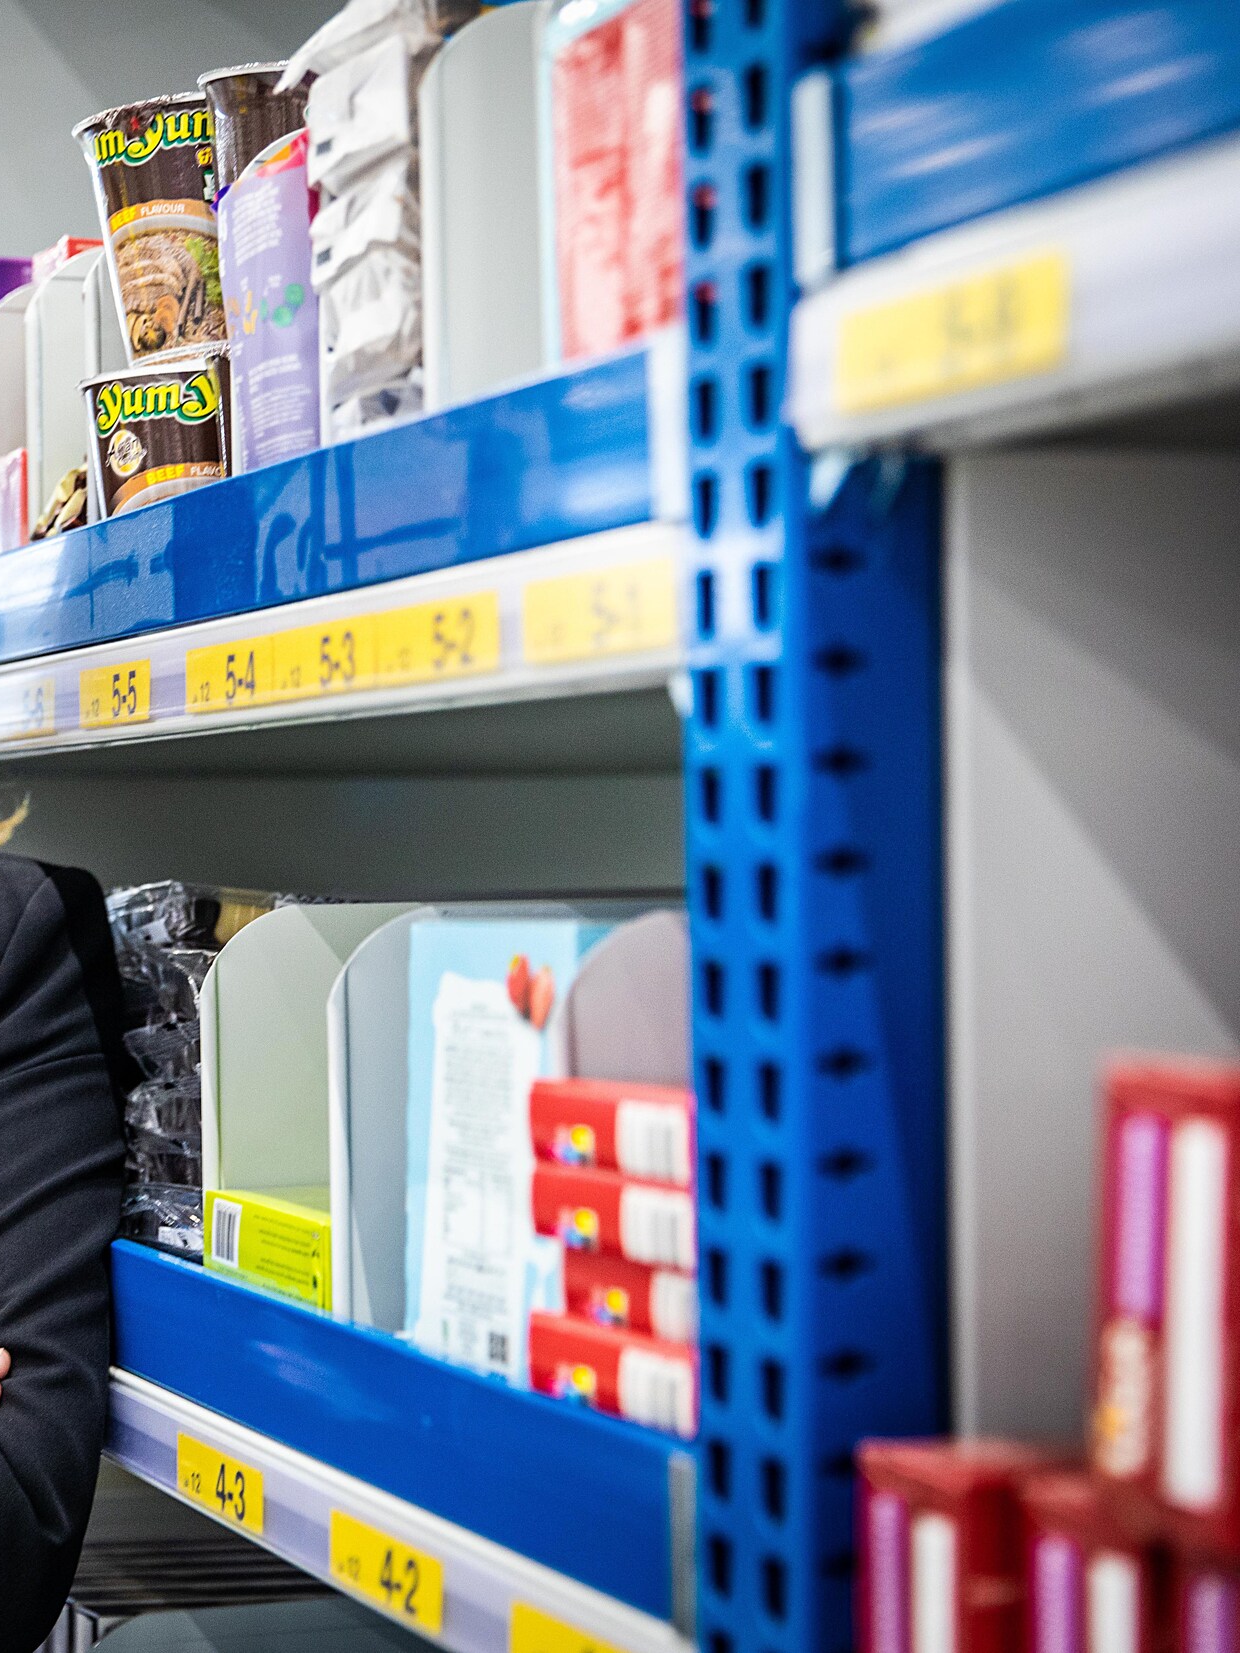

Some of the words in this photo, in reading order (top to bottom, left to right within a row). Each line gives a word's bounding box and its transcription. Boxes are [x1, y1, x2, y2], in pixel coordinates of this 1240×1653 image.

[141, 203, 185, 216] FLAVOUR
[146, 464, 185, 485] BEEF
[319, 630, 356, 687] 5-3
[432, 607, 475, 670] 5-2
[112, 670, 137, 718] 5-5
[225, 650, 255, 701] 5-4
[190, 1471, 201, 1494] 12
[215, 1464, 246, 1521] 4-3
[380, 1549, 420, 1615] 4-2
